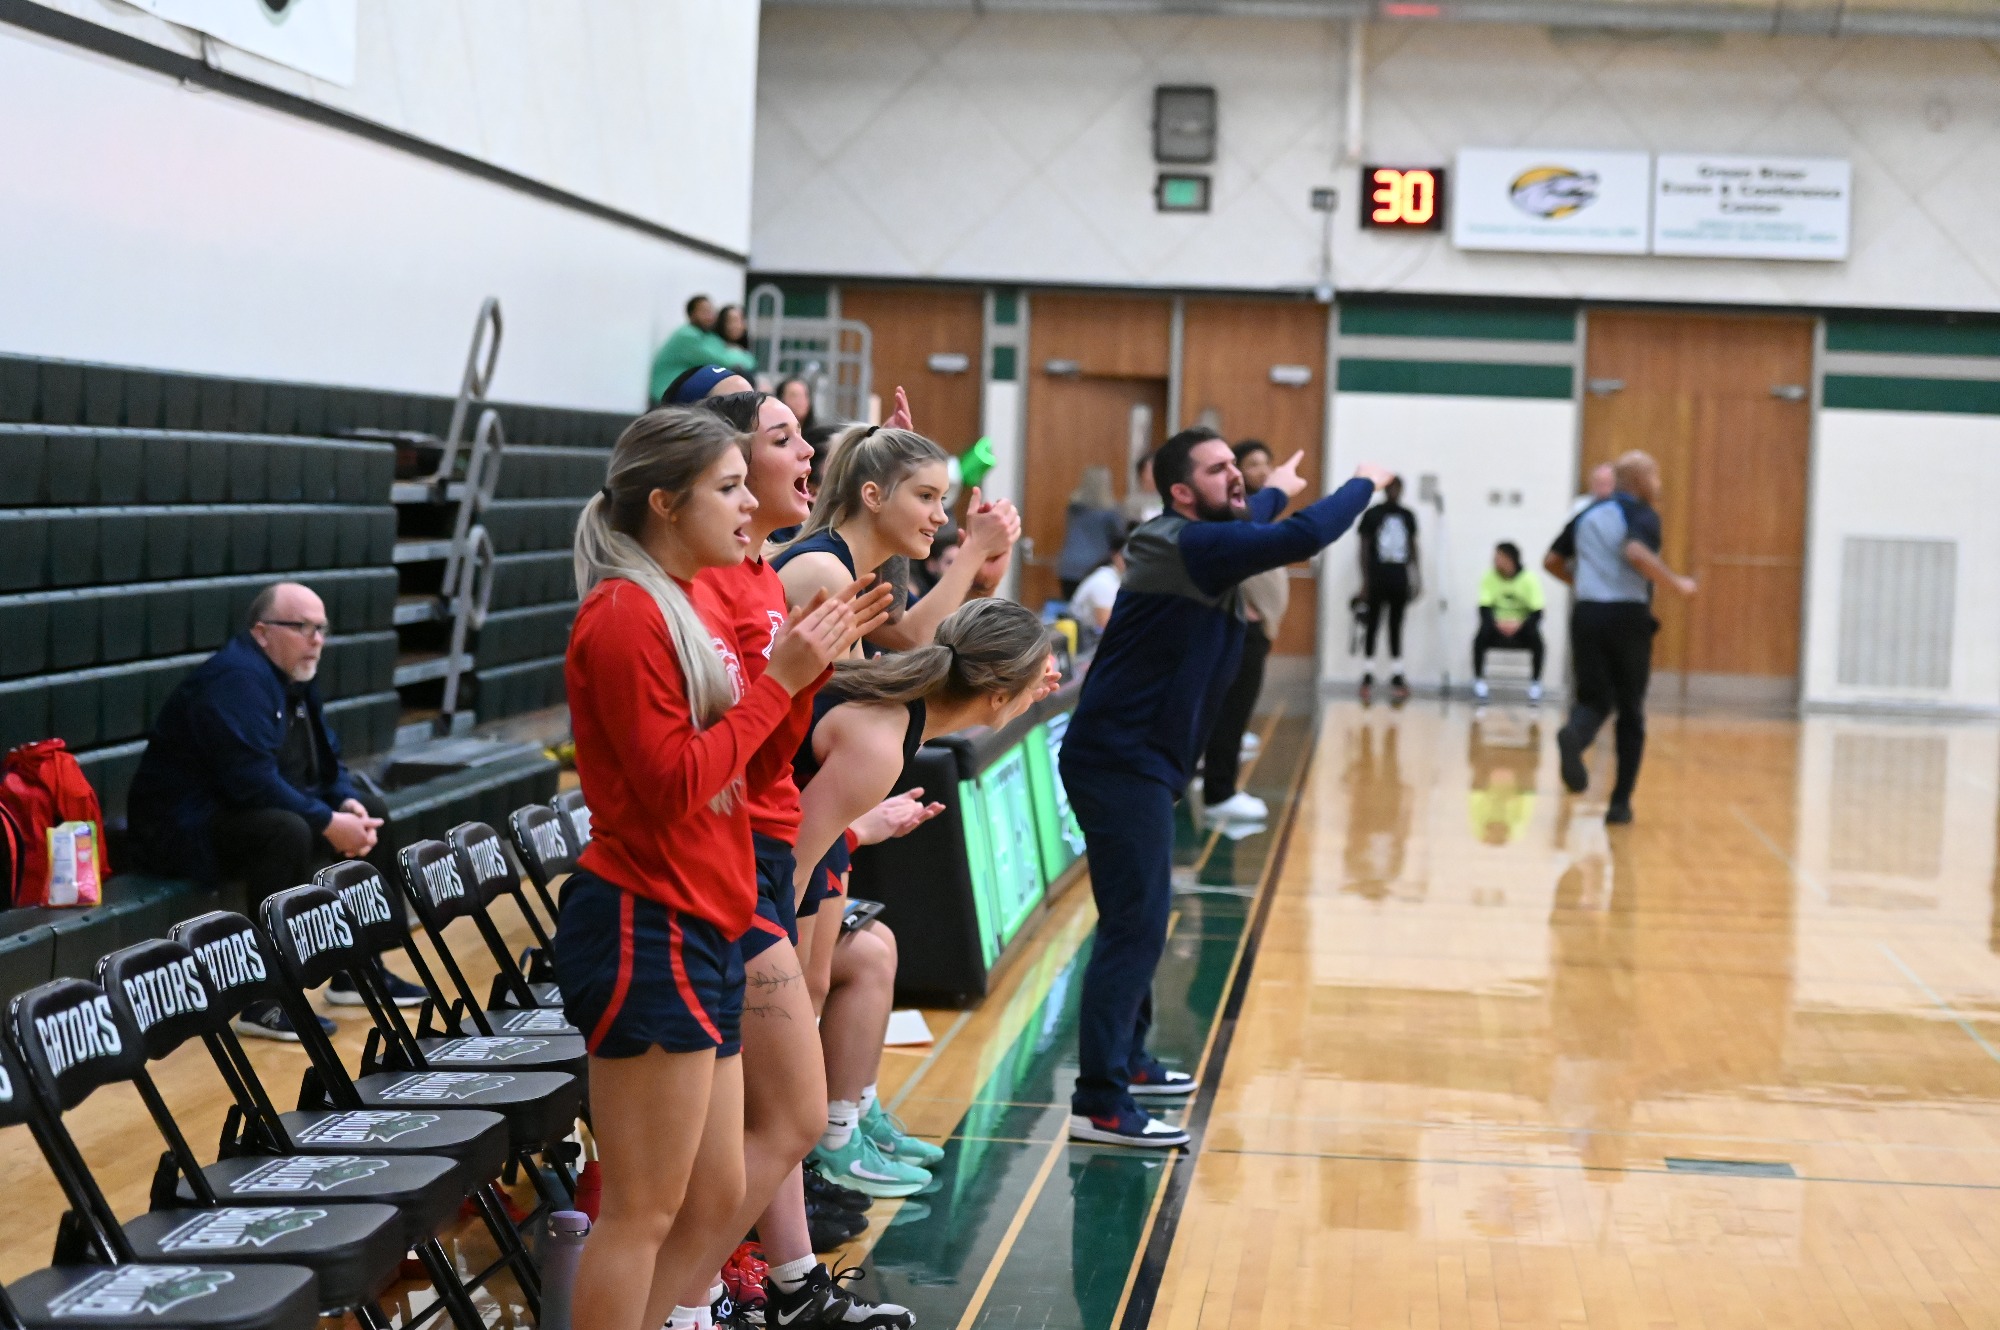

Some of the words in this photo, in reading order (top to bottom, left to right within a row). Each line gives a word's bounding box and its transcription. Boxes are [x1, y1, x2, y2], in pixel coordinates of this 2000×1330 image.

[1373, 169, 1434, 224] 30
[286, 899, 354, 965] GATORS
[122, 957, 209, 1035] GATORS
[34, 994, 123, 1079] GATORS
